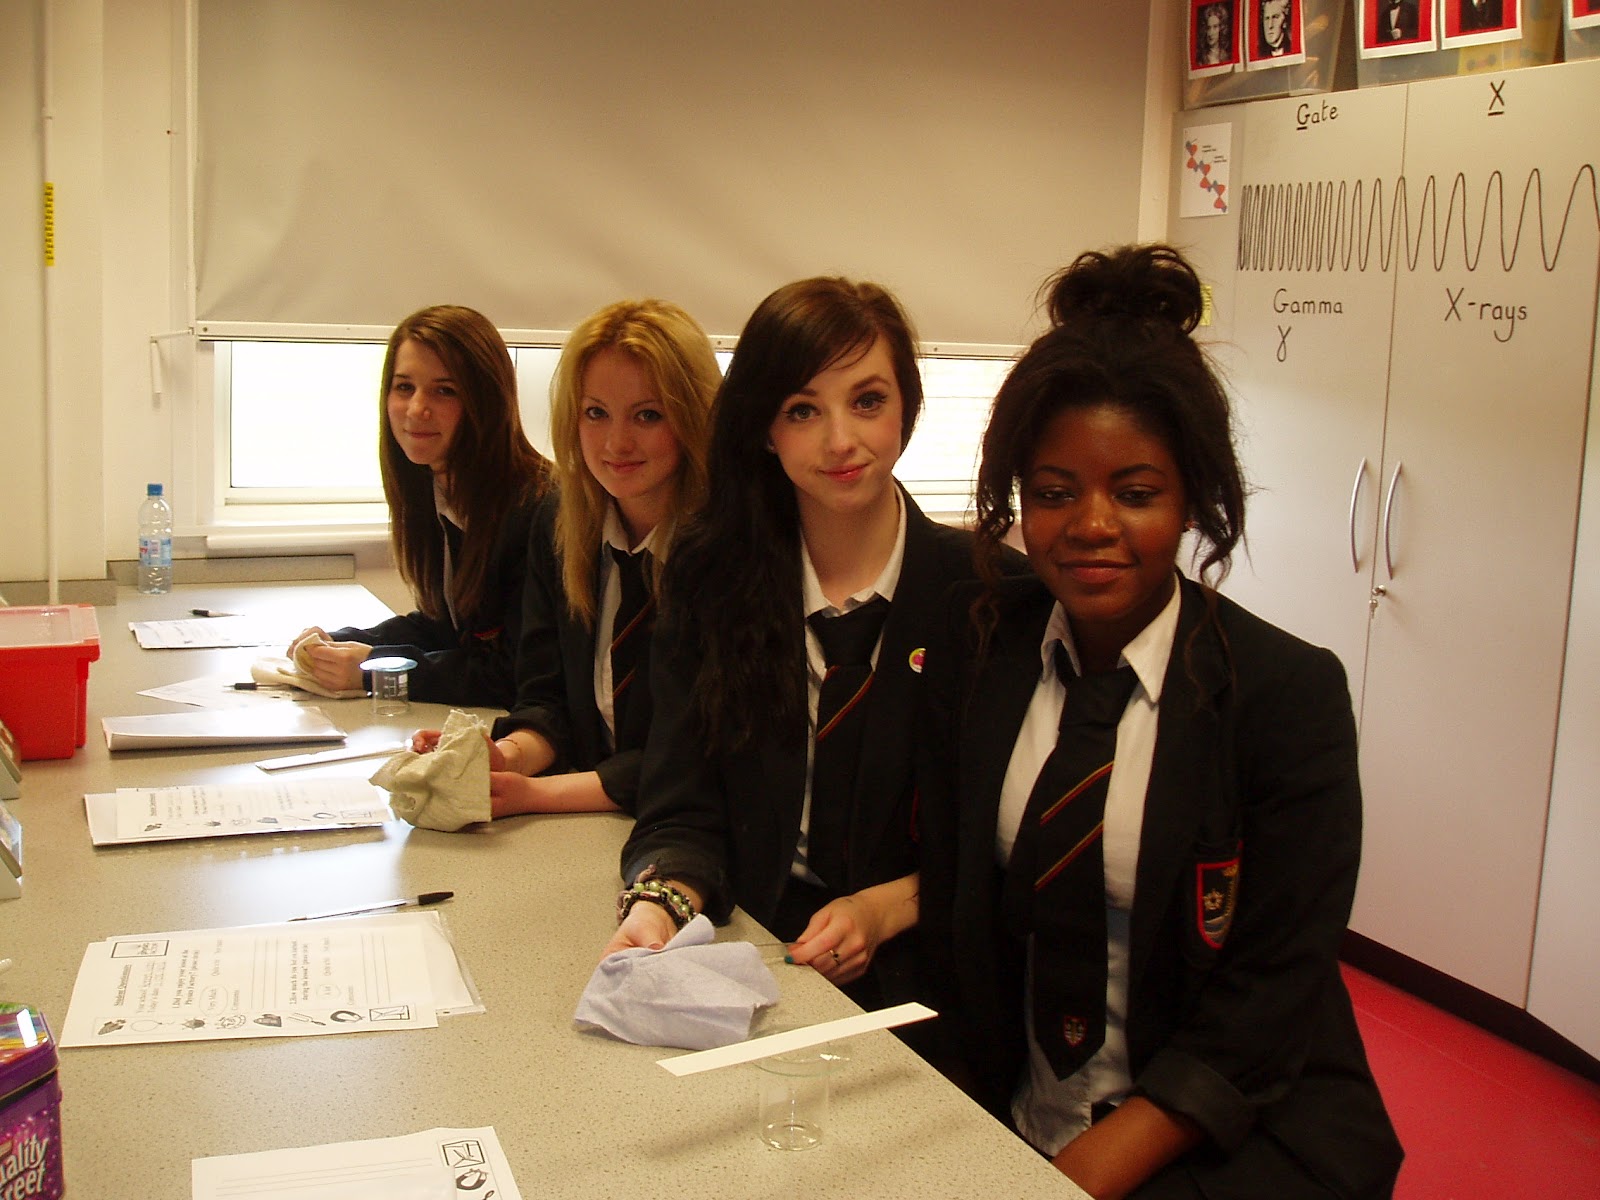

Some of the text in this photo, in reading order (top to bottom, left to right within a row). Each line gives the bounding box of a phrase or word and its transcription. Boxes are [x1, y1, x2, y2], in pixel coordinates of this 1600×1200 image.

[1296, 99, 1339, 131] Gate
[1488, 81, 1505, 116] X
[1273, 288, 1343, 314] Gamma
[1444, 287, 1527, 342] X-rays
